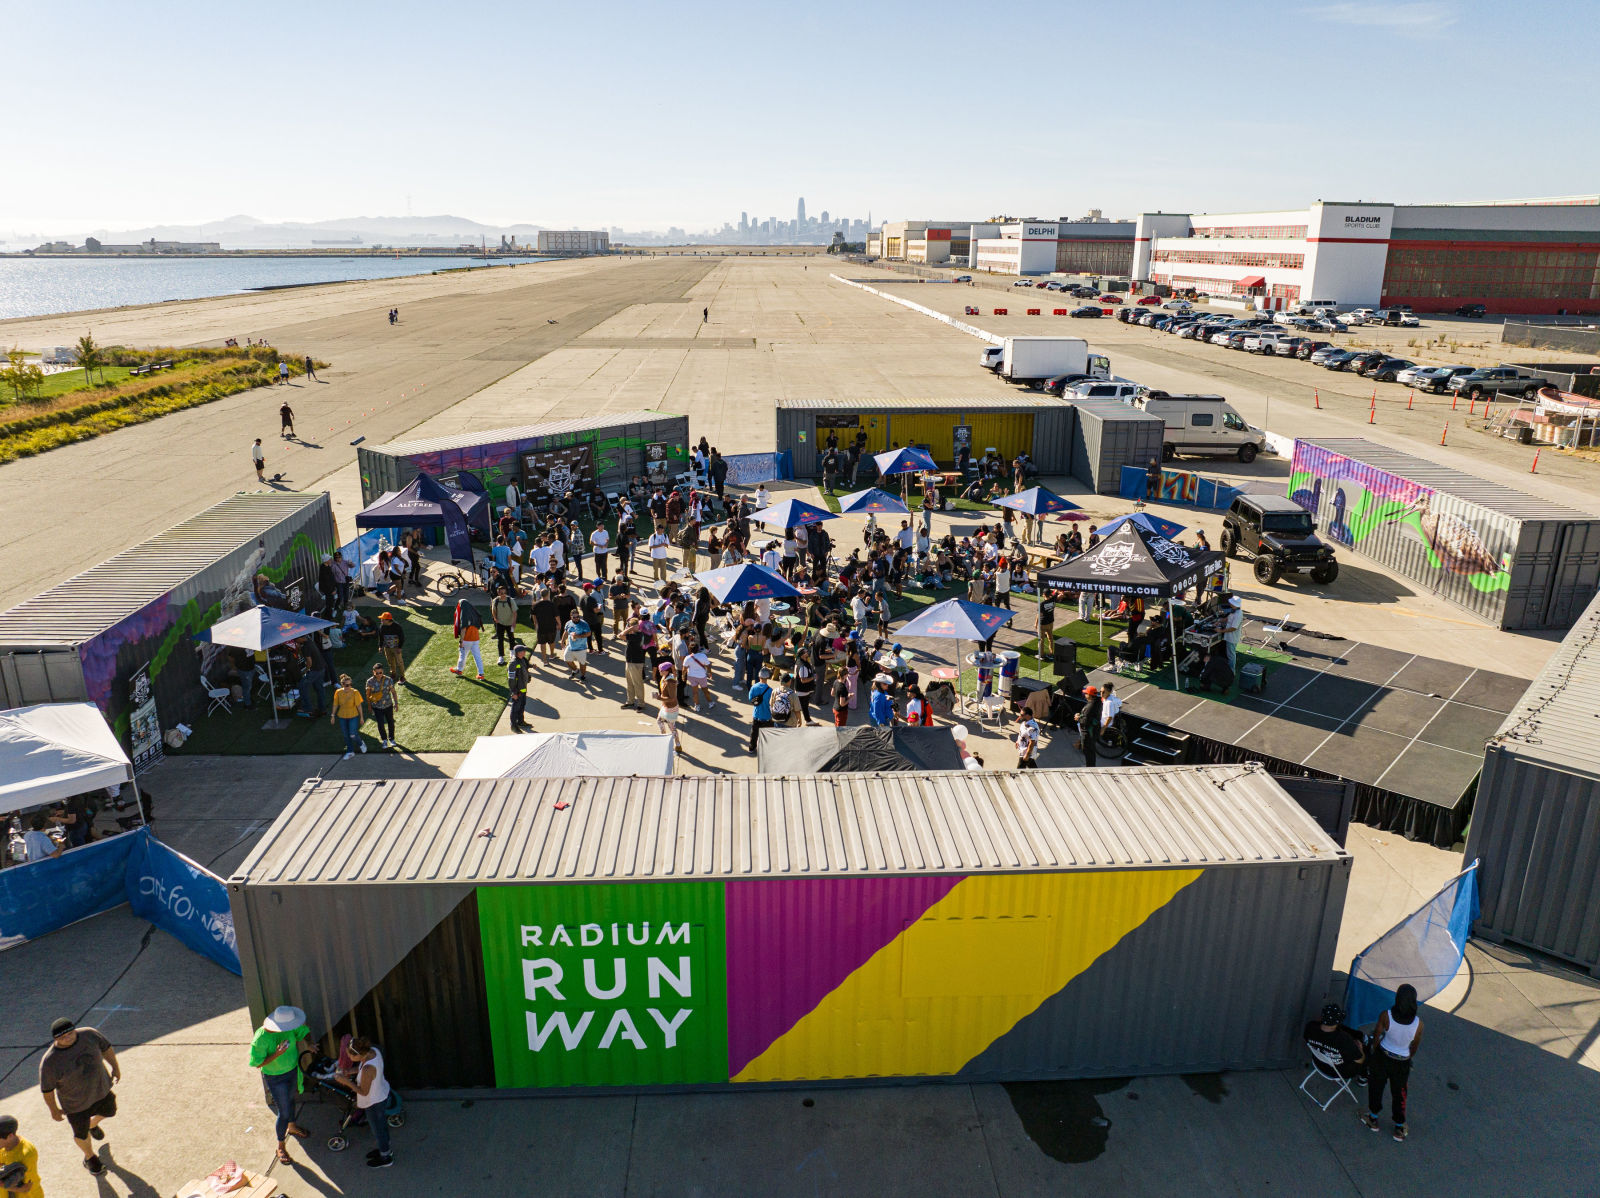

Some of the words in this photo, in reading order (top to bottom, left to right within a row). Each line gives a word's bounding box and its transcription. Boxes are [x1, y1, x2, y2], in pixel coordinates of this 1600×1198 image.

[1028, 227, 1055, 235] DELPHI
[1048, 580, 1159, 596] WWW.THETURFINC.COM
[520, 921, 691, 947] RADIUM
[521, 956, 692, 1001] RUN
[525, 1008, 694, 1052] WAY
